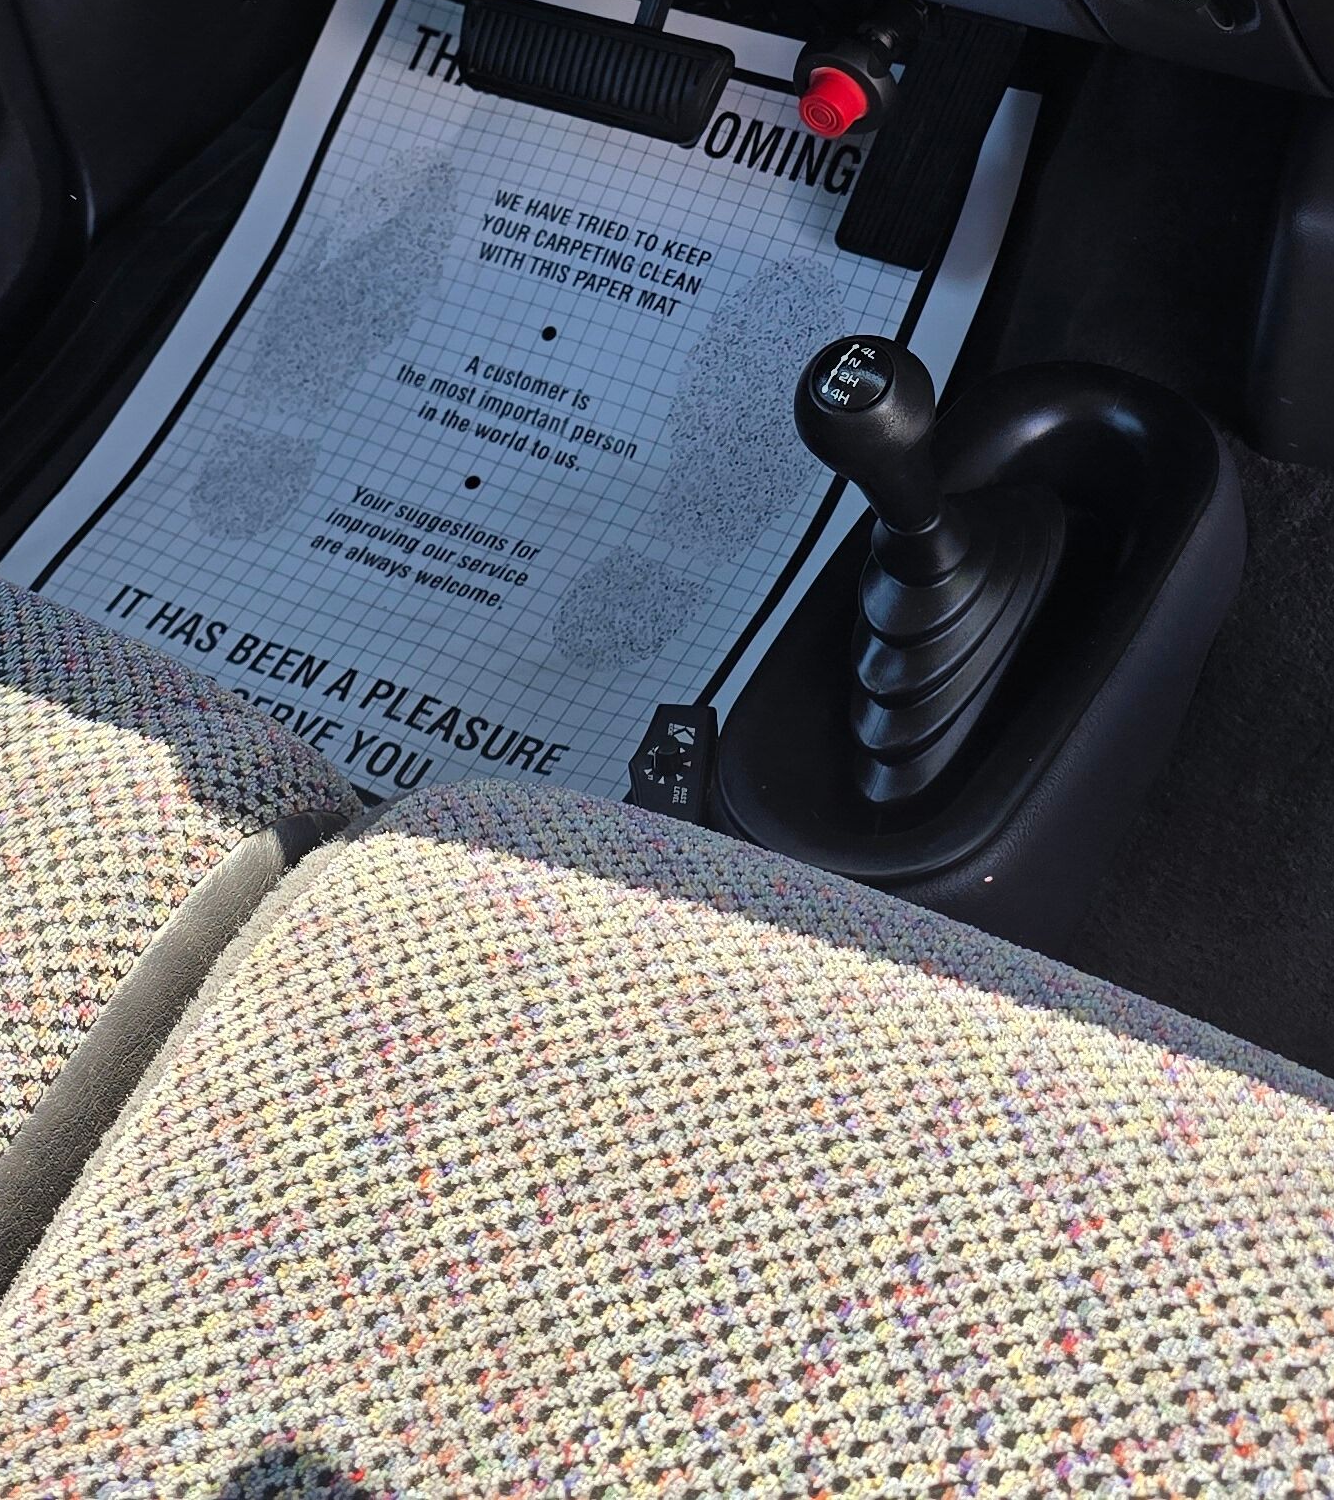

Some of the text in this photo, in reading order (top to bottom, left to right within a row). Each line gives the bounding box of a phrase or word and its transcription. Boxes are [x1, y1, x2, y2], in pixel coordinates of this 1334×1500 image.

[677, 111, 862, 197] OMING
[481, 214, 703, 296] YOUR CARPETING CLEAN
[493, 190, 712, 267] WE HAVE TRIED TO KEEP
[478, 242, 682, 317] WITH THIS PAPER MAT
[464, 356, 591, 411] A customer is
[838, 371, 859, 388] 2H
[848, 357, 861, 368] N
[861, 347, 875, 359] 4L
[396, 364, 638, 459] the most important person
[830, 388, 850, 405] 4H
[417, 401, 580, 471] in the world to us.
[325, 507, 529, 587] improving our service
[350, 486, 541, 561] Your suggestions for
[310, 534, 504, 611] are always welcome.
[104, 584, 571, 776] IT HAS BEEN A PLEASURE
[344, 729, 434, 790] YOU
